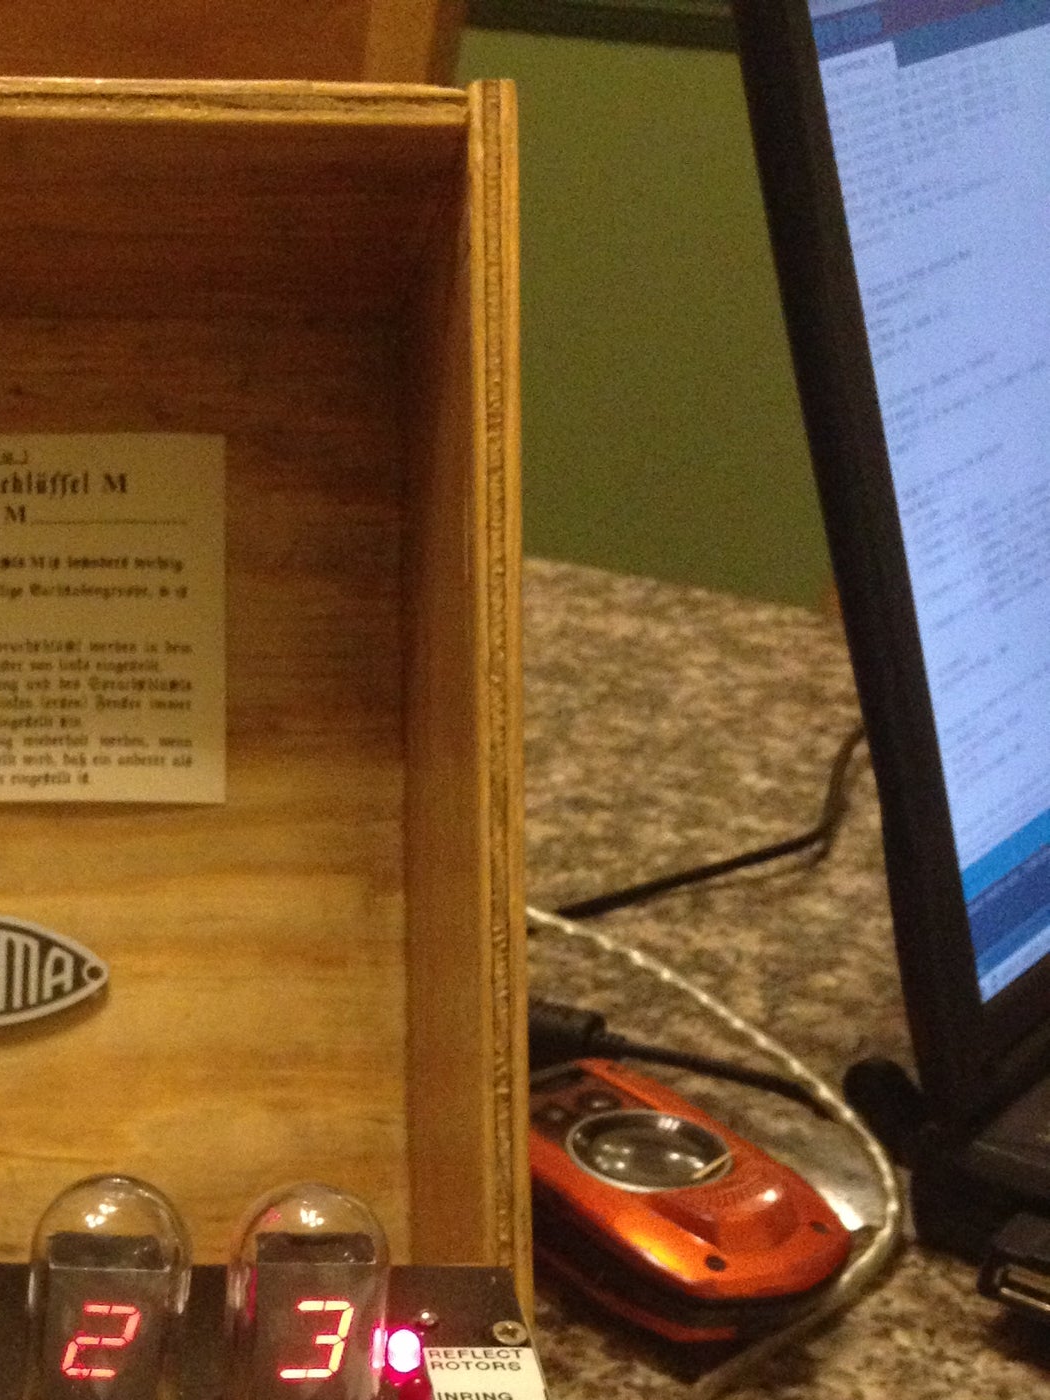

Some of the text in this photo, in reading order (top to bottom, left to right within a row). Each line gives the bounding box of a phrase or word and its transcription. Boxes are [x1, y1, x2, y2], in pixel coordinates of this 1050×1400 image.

[61, 1304, 141, 1378] 2
[278, 1300, 353, 1379] 3
[428, 1349, 523, 1360] REFLECT
[430, 1361, 522, 1371] ROTORS
